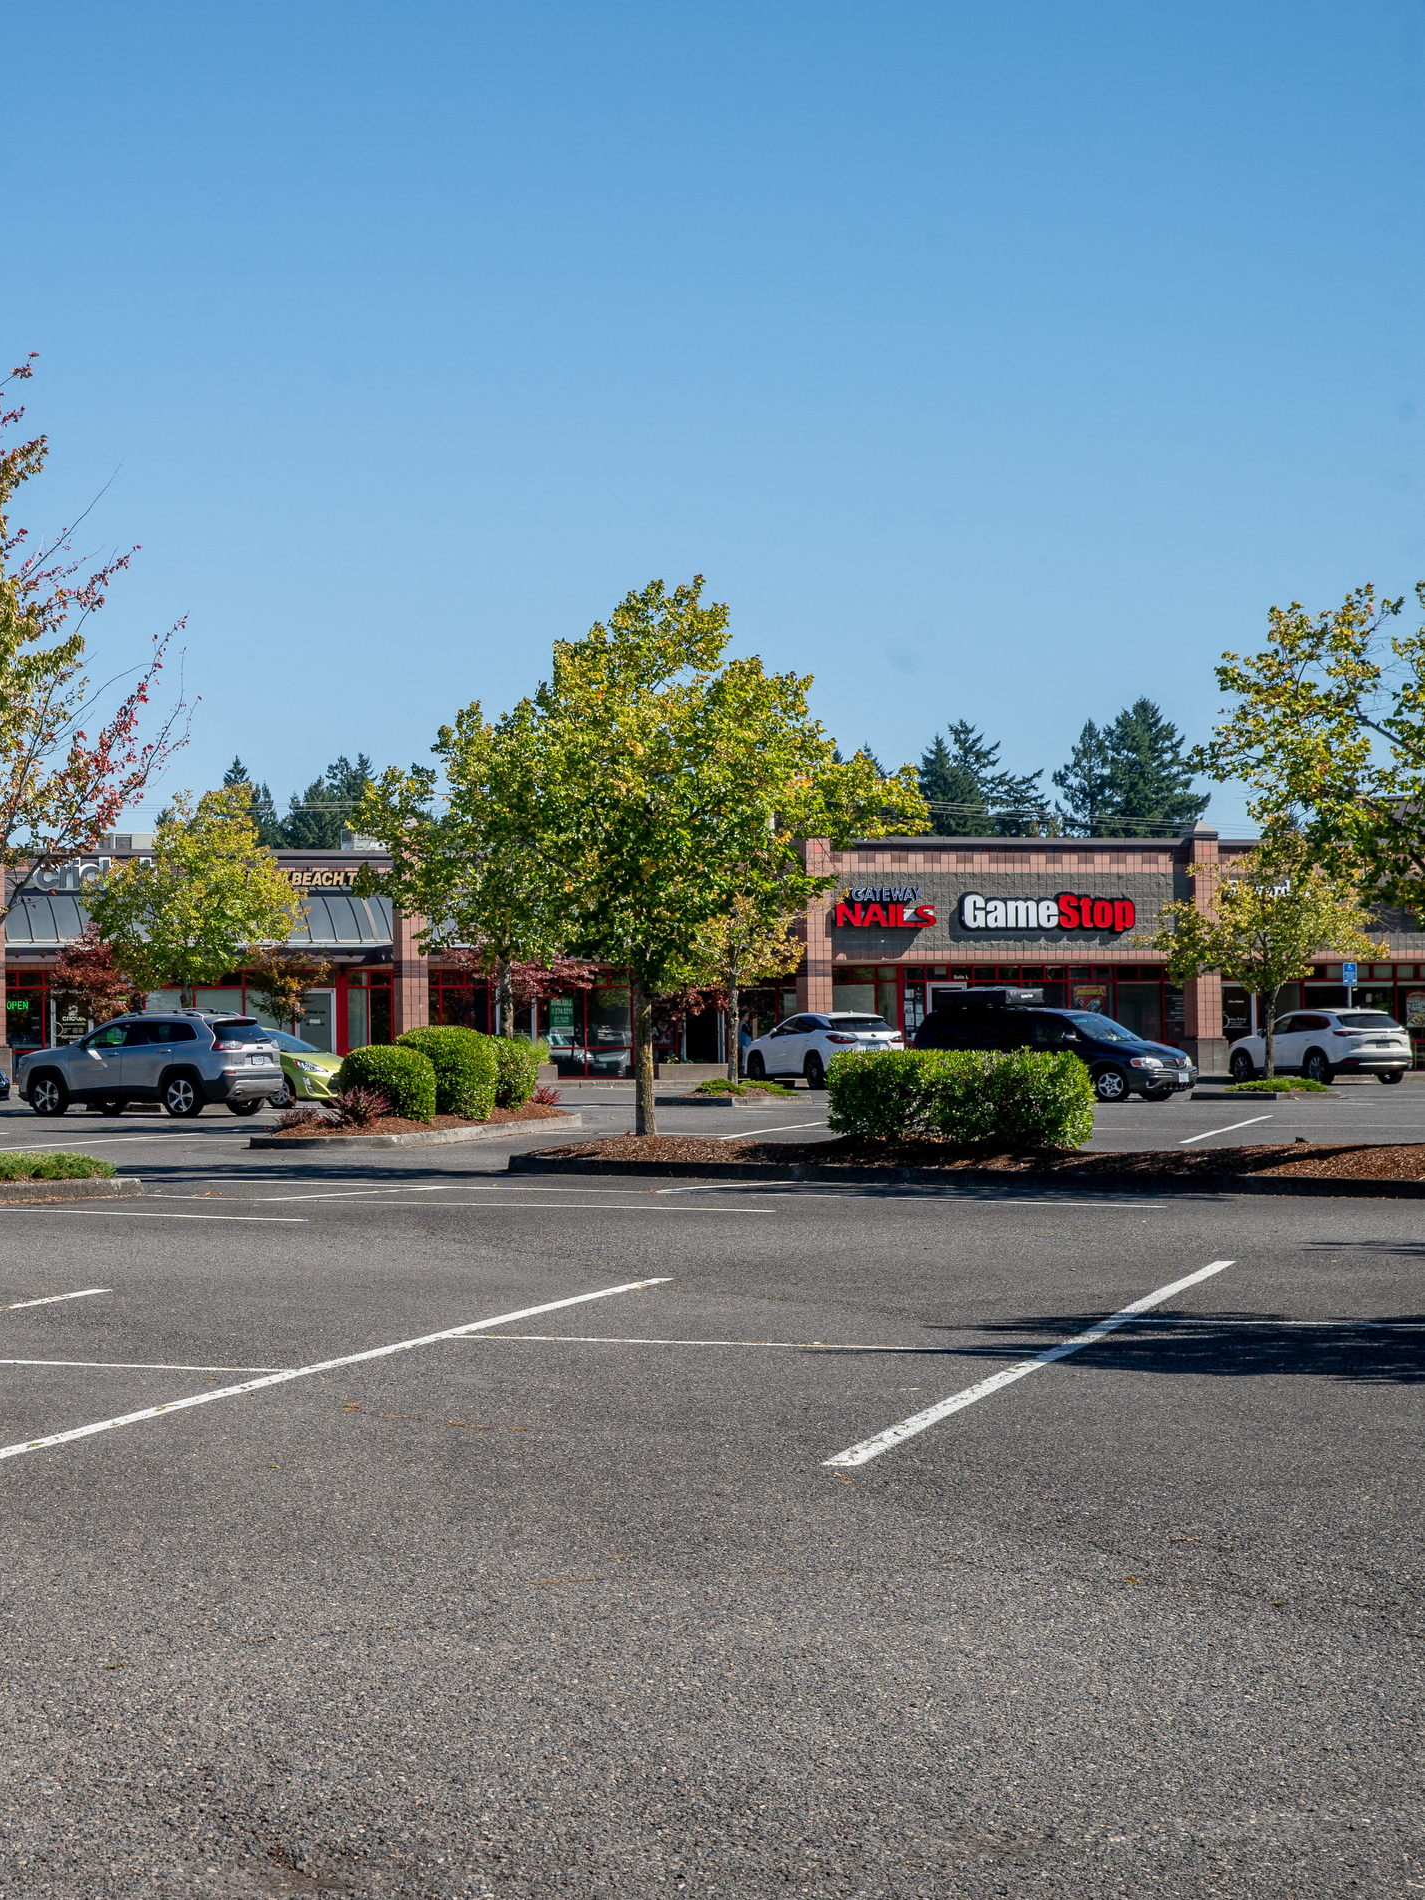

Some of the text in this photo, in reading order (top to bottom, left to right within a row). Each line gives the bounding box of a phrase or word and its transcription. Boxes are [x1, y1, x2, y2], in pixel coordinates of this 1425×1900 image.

[292, 871, 344, 886] BEACH
[851, 887, 922, 902] GATEWAY
[836, 903, 937, 927] NAILS
[964, 894, 1135, 932] GameStop
[6, 1000, 29, 1010] OPEN
